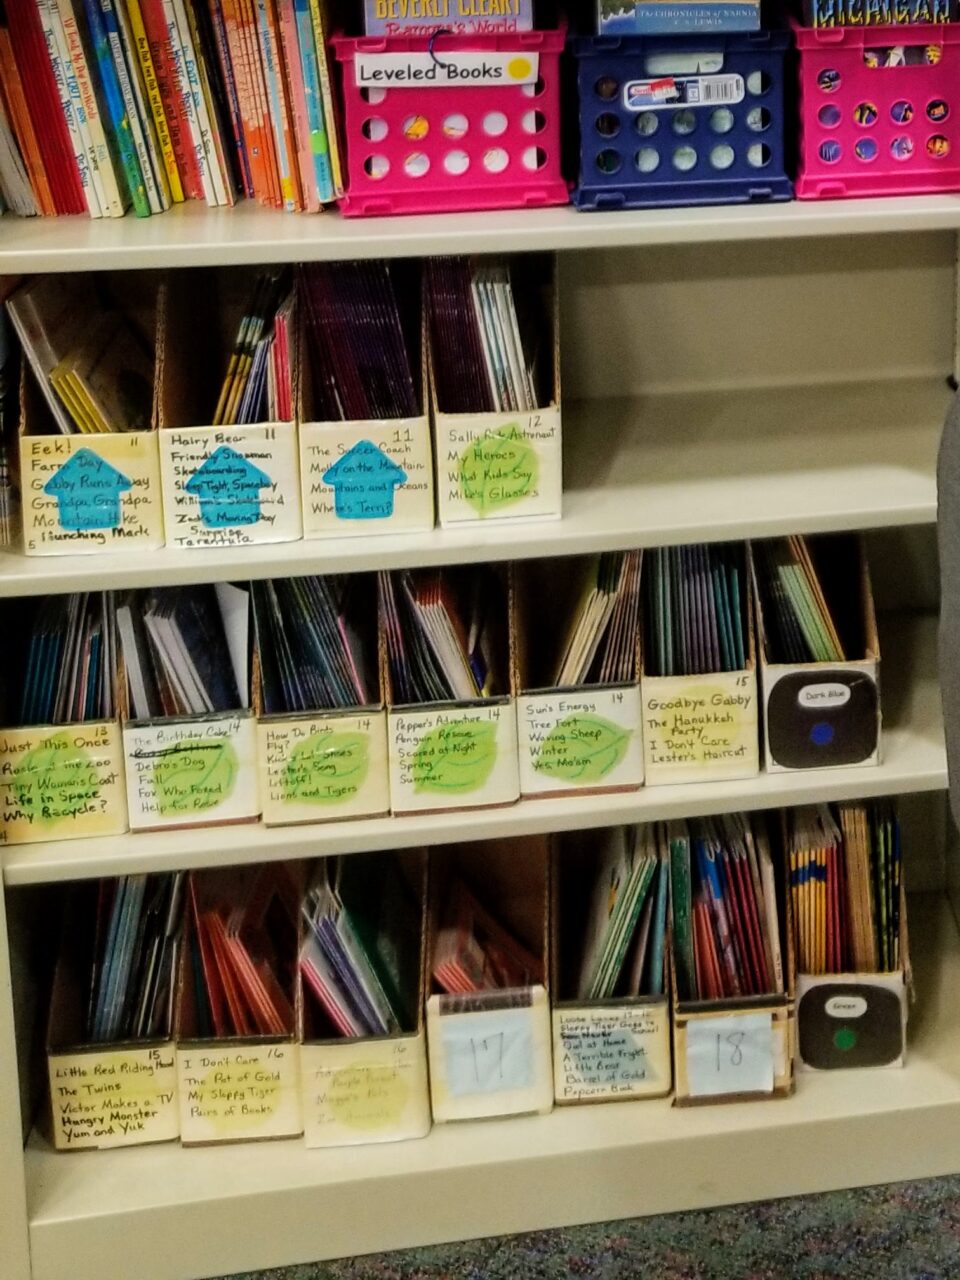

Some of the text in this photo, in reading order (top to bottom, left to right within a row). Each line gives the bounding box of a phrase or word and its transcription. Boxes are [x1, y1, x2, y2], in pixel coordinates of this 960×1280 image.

[723, 9, 757, 17] NARNIA
[469, 18, 518, 33] World
[360, 62, 503, 81] Leveled Books
[529, 416, 542, 428] 12
[171, 428, 275, 448] Hairy Bear 11
[393, 429, 413, 443] 11
[450, 427, 556, 445] Sally Astronaut
[32, 438, 71, 455] Eek!
[308, 446, 330, 456] The
[379, 442, 411, 453] Coach
[171, 449, 272, 464] Friendly Snowman
[448, 449, 516, 465] My Heroes
[32, 456, 103, 472] Farm Day
[357, 462, 374, 472] the
[380, 458, 424, 470] Mountain
[81, 474, 112, 486] Runs
[448, 468, 532, 482] What Kids Say
[311, 483, 387, 493] Mountains and
[93, 493, 151, 508] Grandpa
[191, 526, 243, 538] Surprise
[736, 676, 750, 687] 15
[612, 692, 624, 704] 14
[647, 693, 751, 712] Goodbye Gabby
[526, 701, 597, 715] Sun's Energy
[229, 721, 240, 732] 14
[358, 721, 370, 730] 14
[396, 718, 433, 733] Pepper's
[489, 708, 500, 720] 14
[526, 720, 551, 729] Tree
[647, 719, 667, 729] The
[157, 726, 228, 742] Birthday Cake
[267, 731, 288, 741] How
[292, 728, 305, 737] Do
[395, 729, 474, 746] Penguin Rescue
[570, 729, 602, 740] Sheep
[671, 726, 703, 738] Party
[0, 737, 111, 753] Just This Once
[267, 741, 290, 753] Fly?
[398, 741, 477, 758] Scared at Night
[650, 736, 730, 750] I Don't Care
[529, 745, 568, 757] Winter
[651, 744, 748, 763] Lester's Haircut
[180, 757, 205, 770] Dog
[313, 761, 337, 775] Song
[399, 760, 433, 772] Spring
[88, 772, 119, 786] Coat
[400, 774, 443, 785] Summer
[5, 790, 101, 806] Life in Space
[302, 788, 319, 797] and
[324, 786, 358, 797] Tigers
[142, 803, 167, 813] Help
[3, 810, 34, 824] Why
[148, 1050, 160, 1060] 15
[267, 1048, 284, 1059] 16
[563, 1053, 571, 1062] A
[717, 1031, 746, 1072] 18
[184, 1055, 260, 1069] I Don't Care
[56, 1062, 154, 1077] Little Red Riding
[184, 1071, 280, 1086] The Pot of Gold
[58, 1082, 122, 1096] The Twins
[188, 1086, 276, 1102] My Sloppy Tiger
[60, 1102, 96, 1114] Victor
[102, 1098, 138, 1110] Makes
[156, 1091, 174, 1104] TV
[61, 1108, 159, 1127] Hungry Monster
[190, 1104, 273, 1117] Pairs of Books
[62, 1121, 145, 1143] Yum and Yuk
